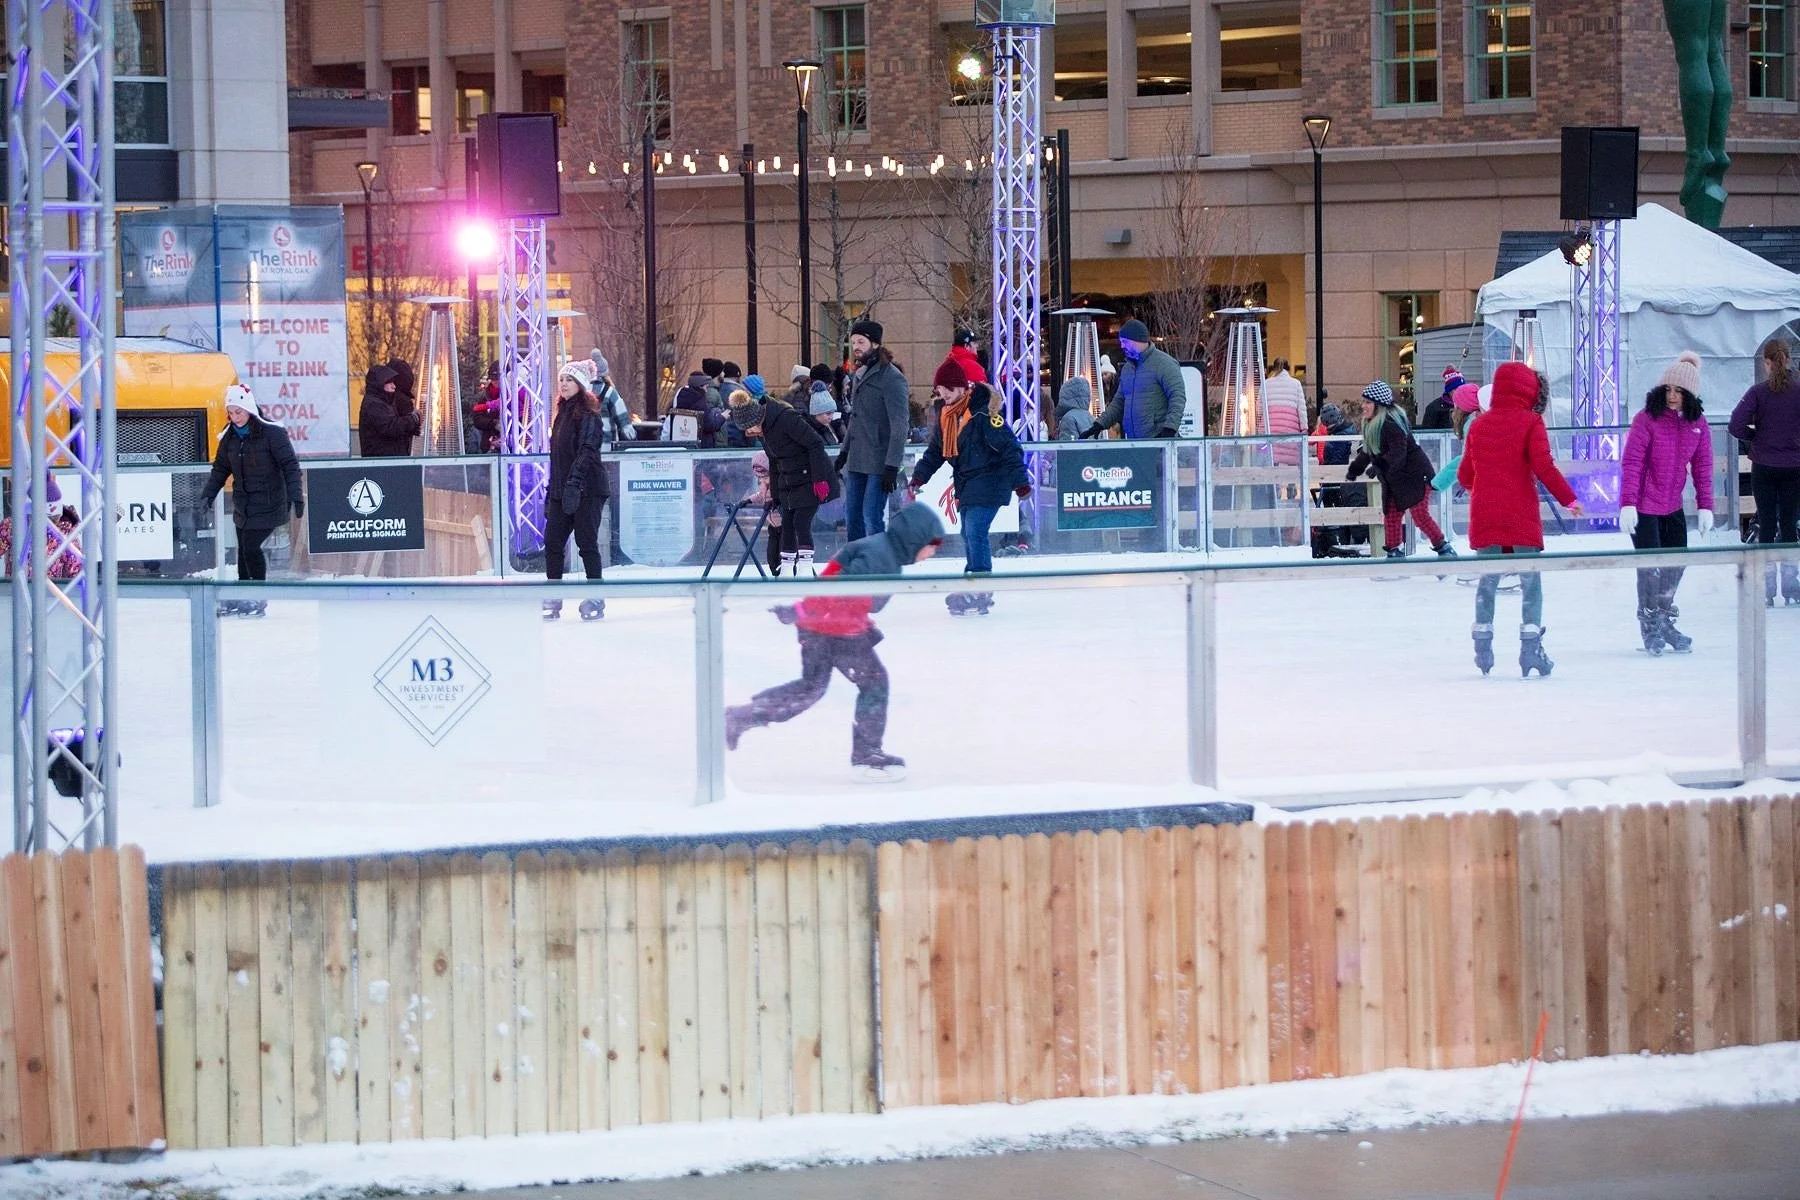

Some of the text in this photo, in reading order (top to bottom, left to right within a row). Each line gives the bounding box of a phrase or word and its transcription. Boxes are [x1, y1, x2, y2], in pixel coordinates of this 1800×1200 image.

[240, 318, 330, 335] WELCOME
[275, 339, 300, 356] TO
[245, 360, 329, 378] THE RINK
[278, 382, 301, 399] AT
[259, 403, 320, 420] ROYAL
[286, 424, 309, 441] AK
[632, 480, 683, 489] RINK WAIVER
[1063, 490, 1152, 508] ENTRANCE
[327, 518, 407, 533] ACCUFORM
[326, 531, 364, 540] PRINTING
[371, 529, 407, 538] SIGNAGE
[410, 657, 455, 682] M3
[400, 684, 465, 693] INVESTMENT
[408, 693, 457, 701] SERVICES
